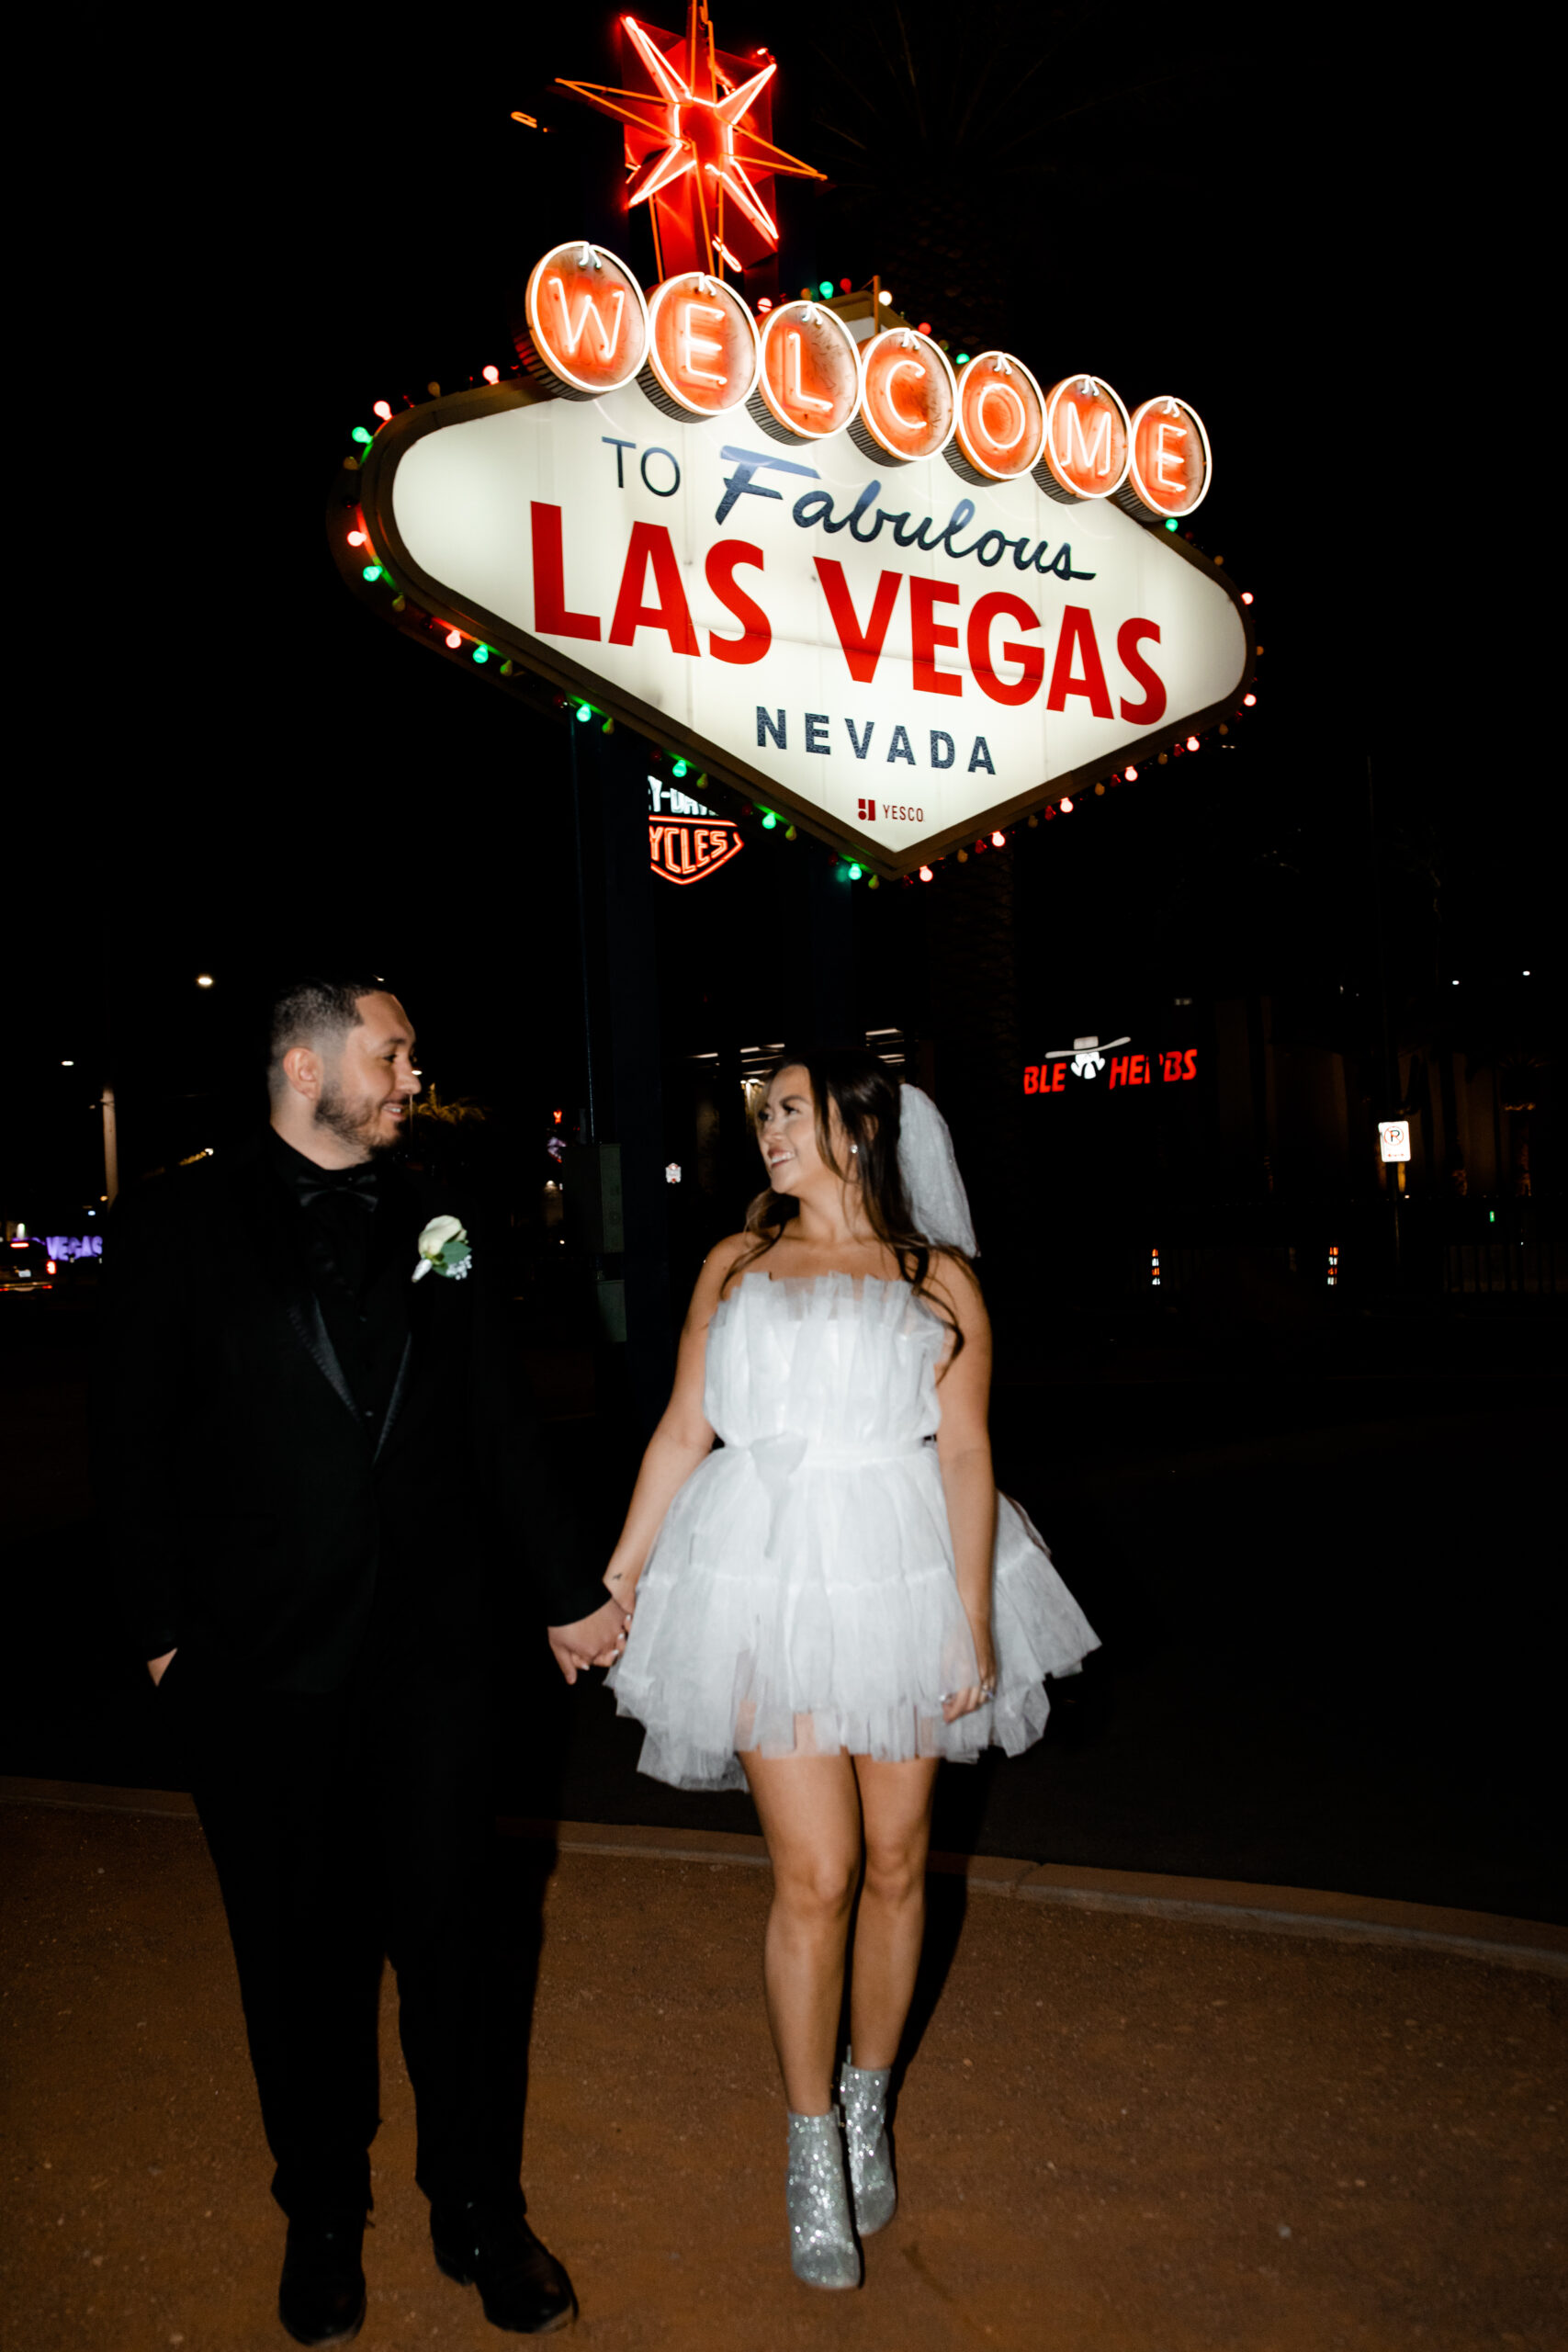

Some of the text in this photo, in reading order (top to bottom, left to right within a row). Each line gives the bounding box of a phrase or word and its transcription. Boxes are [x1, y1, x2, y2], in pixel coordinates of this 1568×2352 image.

[547, 276, 1188, 492] WELCOME
[602, 435, 1097, 581] TO Fabulous
[530, 501, 1168, 726] LAS VEGAS
[756, 706, 997, 775] NEVADA
[883, 804, 924, 823] YESCO
[649, 825, 728, 875] YCLES
[1023, 1062, 1067, 1095] BLE
